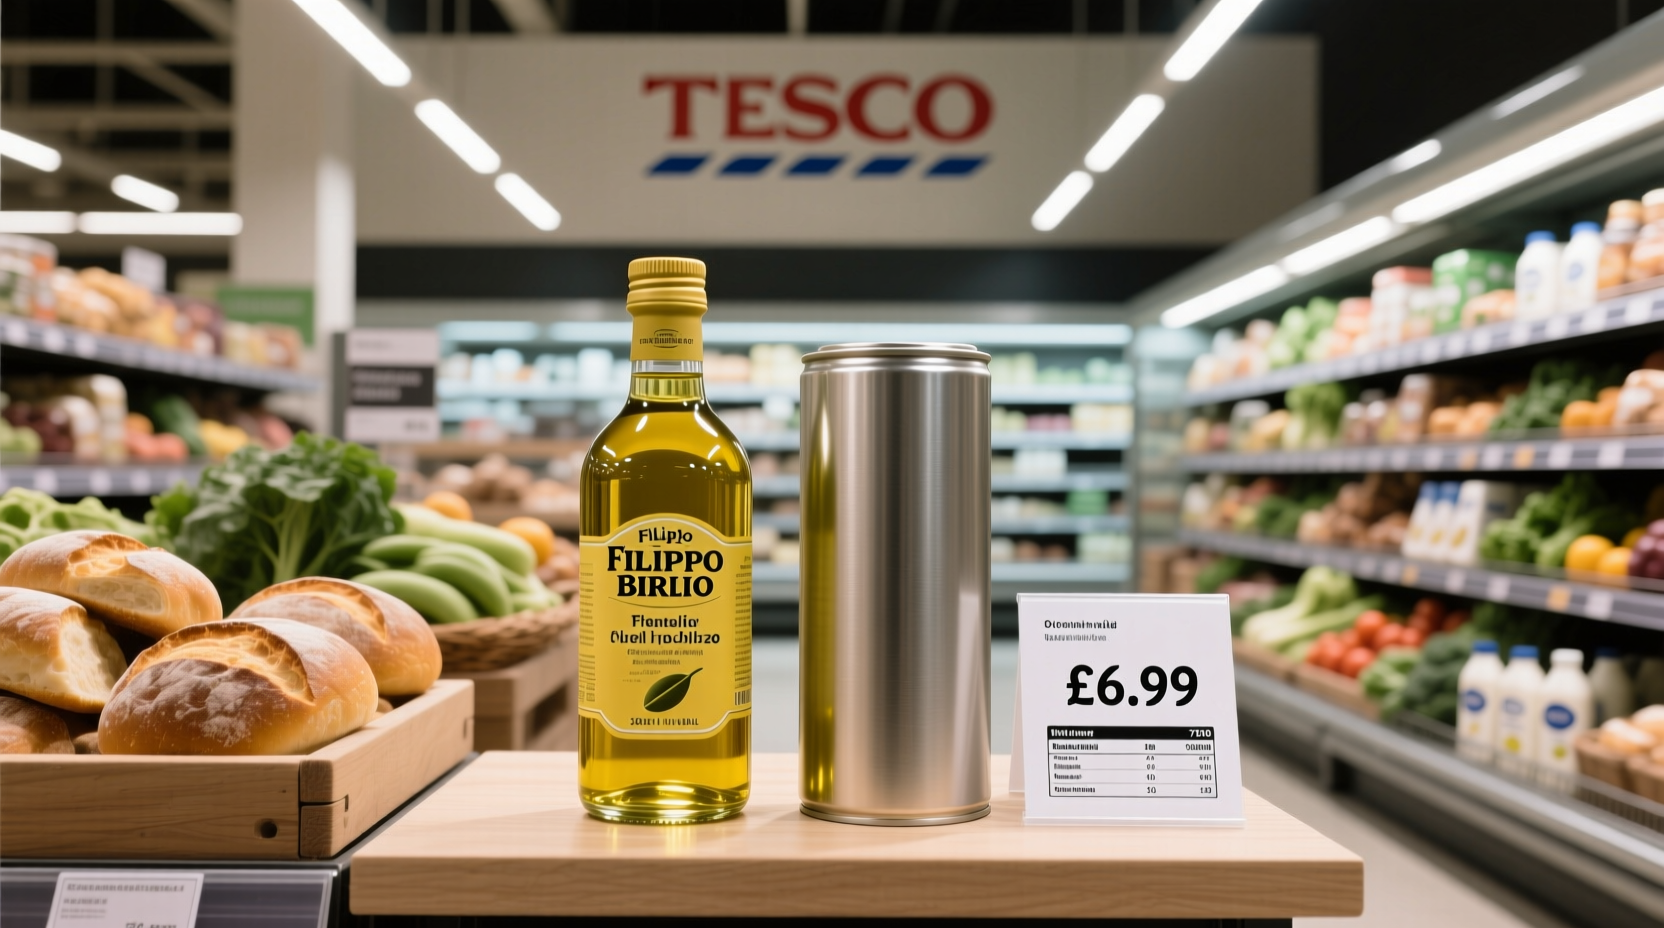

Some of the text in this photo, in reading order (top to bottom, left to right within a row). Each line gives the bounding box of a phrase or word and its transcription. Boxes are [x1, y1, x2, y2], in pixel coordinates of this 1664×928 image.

[643, 72, 995, 143] TESCO
[607, 545, 724, 573] FILIPPO
[616, 574, 714, 597] BIRLIO
[1066, 663, 1198, 707] £6.99
